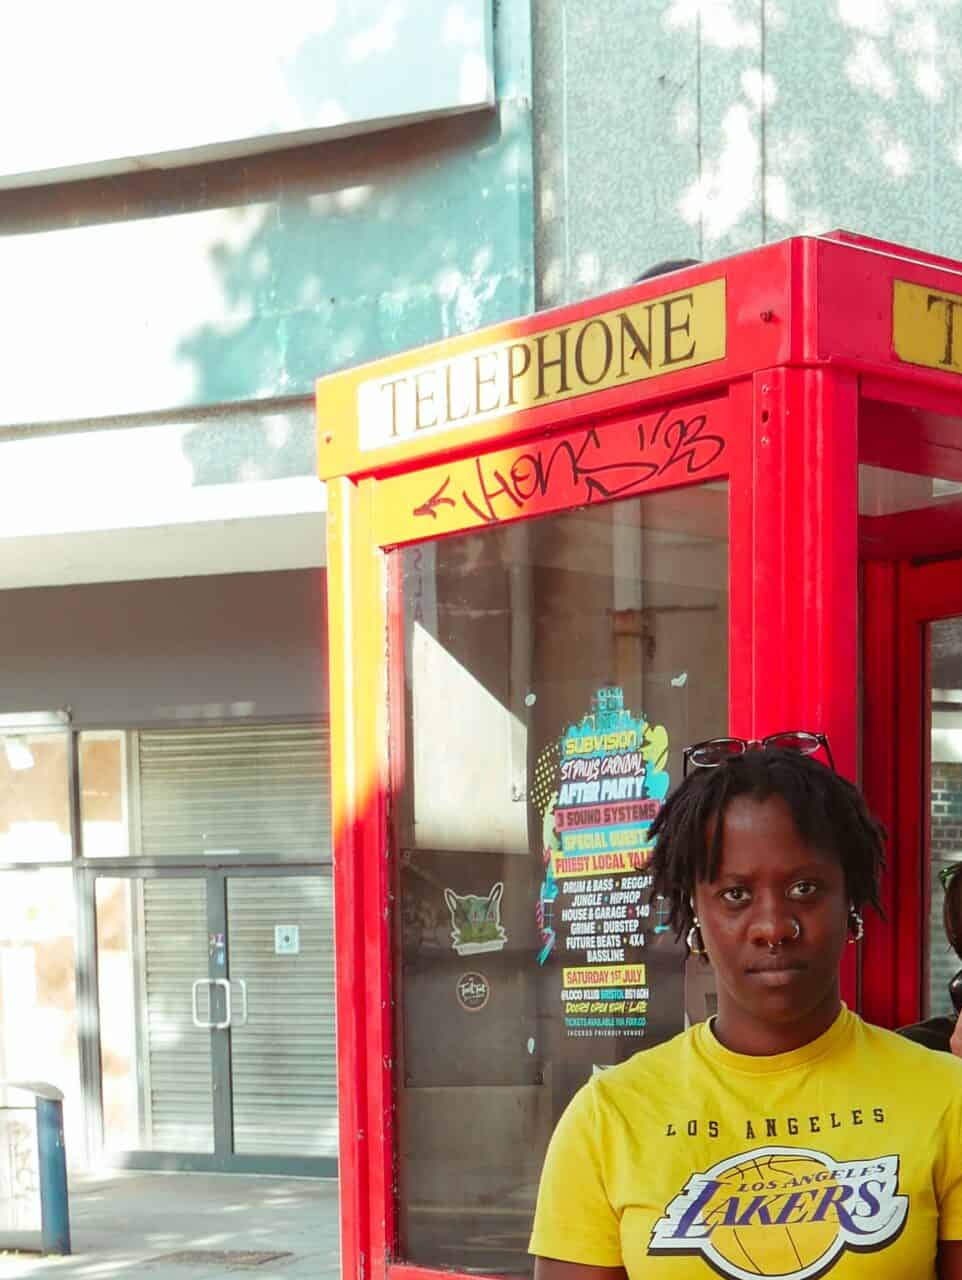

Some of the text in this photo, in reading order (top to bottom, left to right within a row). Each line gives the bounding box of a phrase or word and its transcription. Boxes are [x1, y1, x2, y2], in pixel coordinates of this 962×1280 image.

[380, 293, 697, 437] TELEPHONE
[559, 776, 645, 806] AFTER PARTY
[566, 807, 600, 826] SOUND
[603, 802, 657, 822] SYSTEMS
[591, 853, 625, 871] LOCAL
[592, 878, 614, 892] BASS
[571, 891, 641, 907] JUNGLE HIPHOP
[561, 908, 588, 921] HOUSE
[594, 906, 628, 920] GARAGE
[635, 904, 650, 918] 140
[571, 919, 640, 935] GRIME DUBSTEP
[566, 935, 596, 949] FUTURE
[596, 934, 622, 948] BEATS
[586, 949, 625, 962] BASSLINE
[567, 970, 609, 985] SATURDAY
[623, 969, 642, 984] JULY
[667, 1108, 885, 1139] LOS ANGELES
[736, 1162, 887, 1192] LOS ANGELES
[662, 1178, 897, 1240] LAKERS
